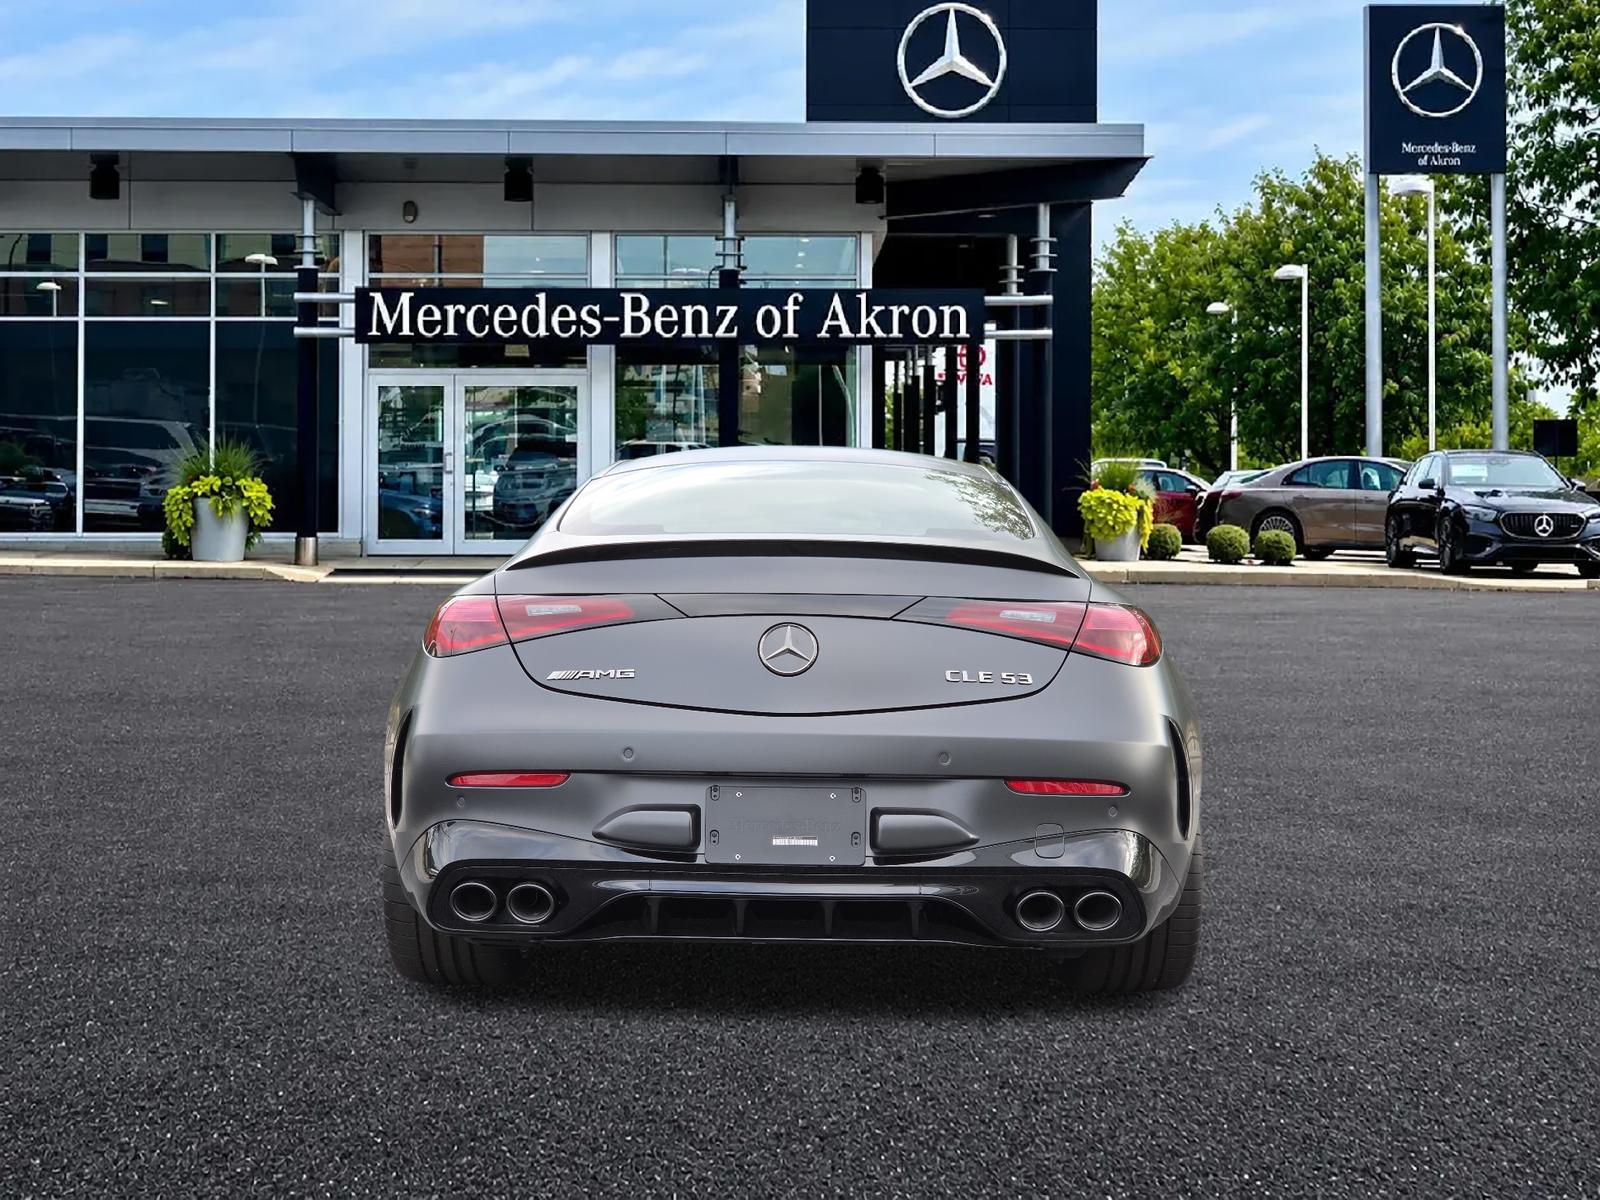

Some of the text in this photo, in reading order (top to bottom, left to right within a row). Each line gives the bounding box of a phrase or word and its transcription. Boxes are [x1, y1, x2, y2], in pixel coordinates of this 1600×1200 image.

[1401, 141, 1477, 154] Mercedes-Benz
[1417, 154, 1462, 166] of Akron
[367, 290, 971, 340] Mercedes-Benz of Akron
[944, 669, 1034, 686] CLE 53
